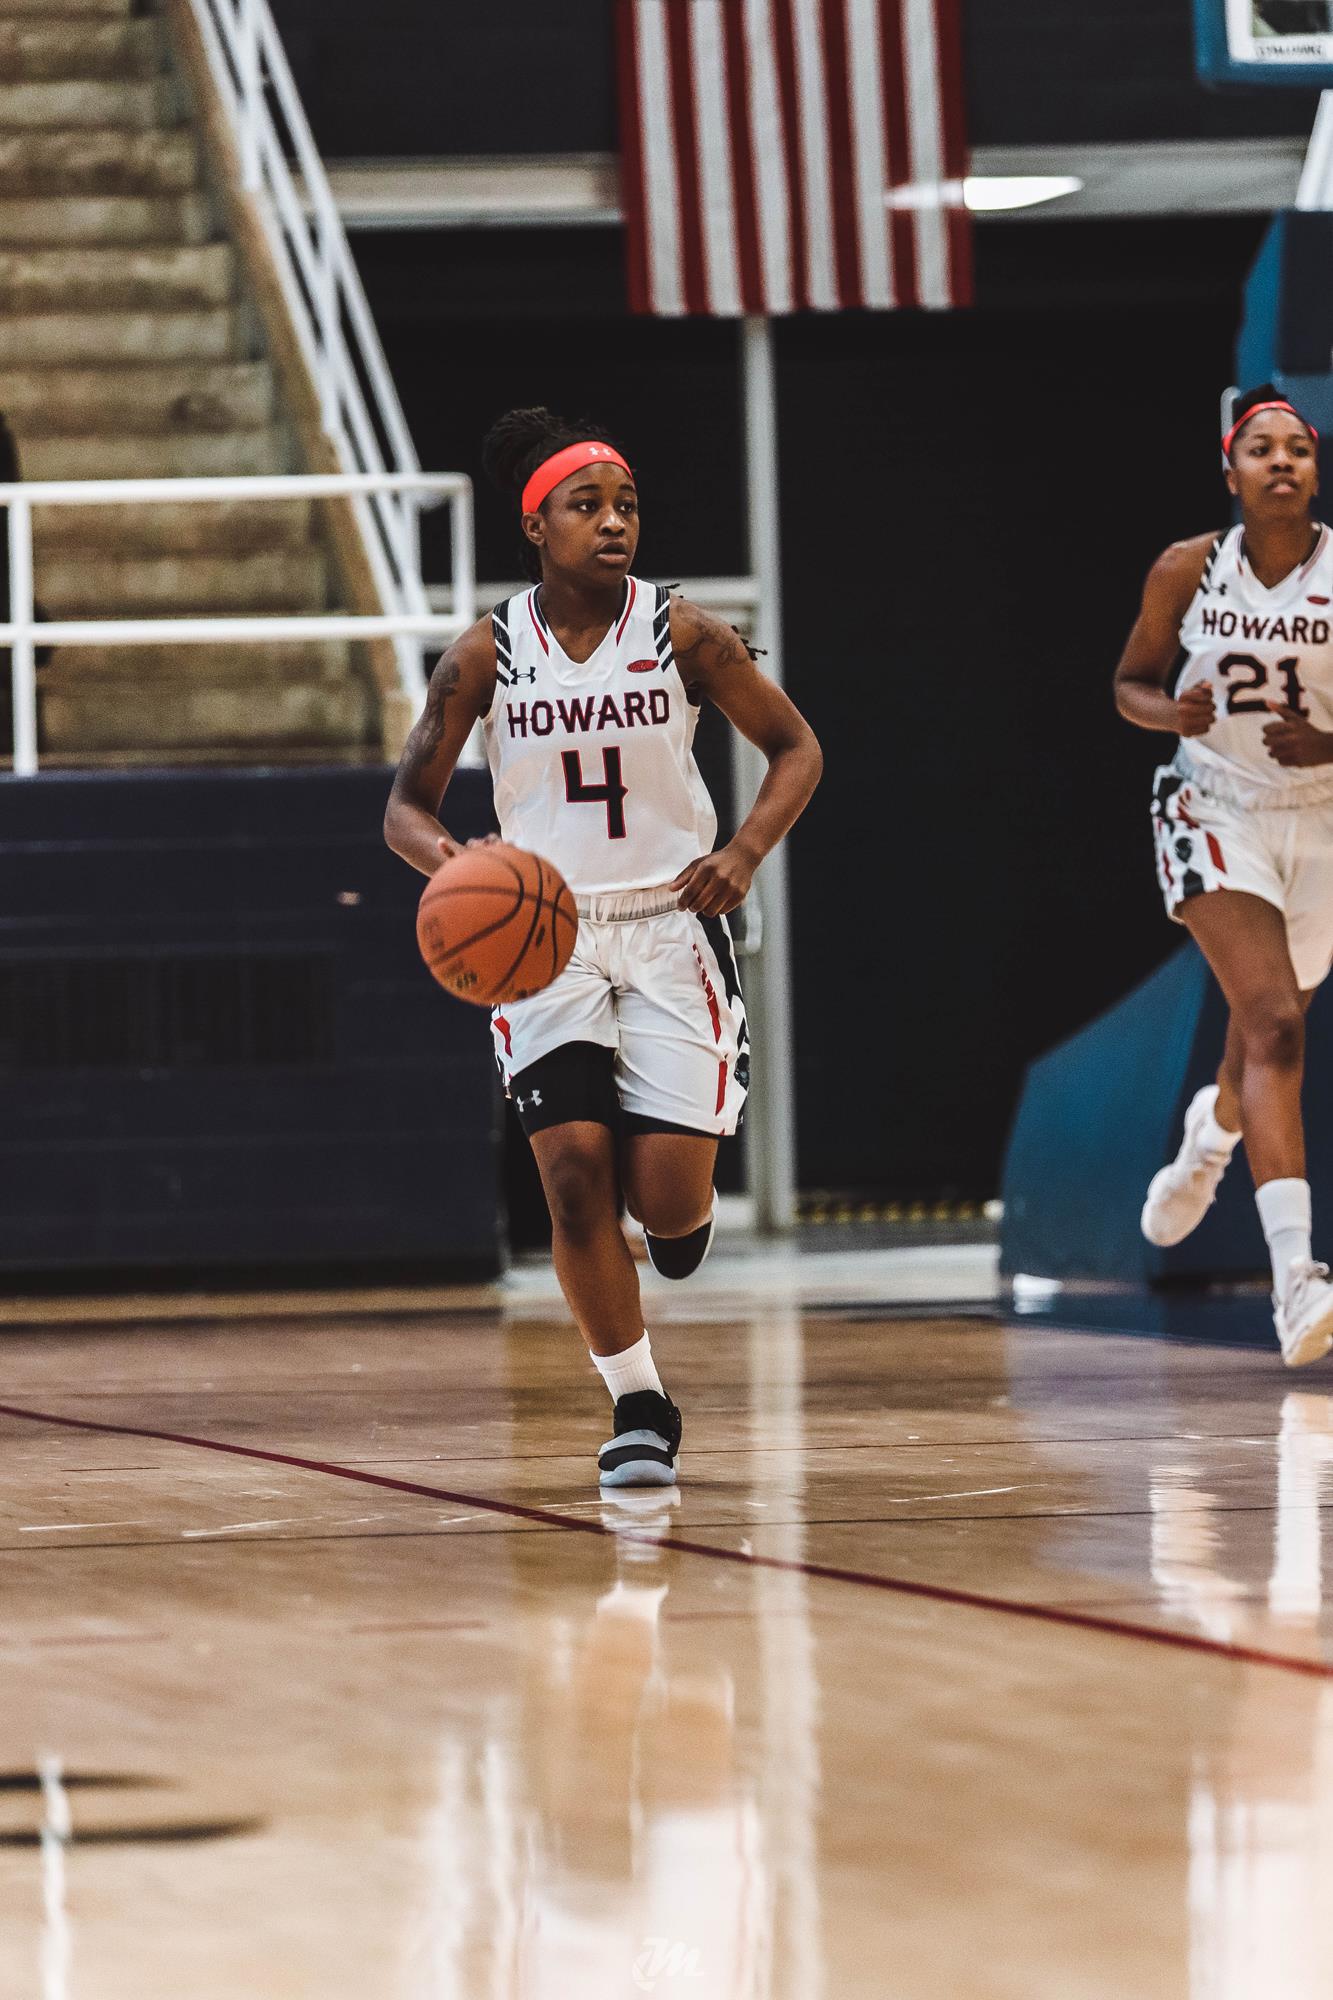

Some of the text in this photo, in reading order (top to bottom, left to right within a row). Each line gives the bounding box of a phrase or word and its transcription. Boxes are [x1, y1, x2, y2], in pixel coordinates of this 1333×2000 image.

[1202, 608, 1330, 645] HOWARD
[507, 688, 670, 738] HOWARD
[1217, 652, 1309, 719] 21
[561, 745, 629, 840] 4
